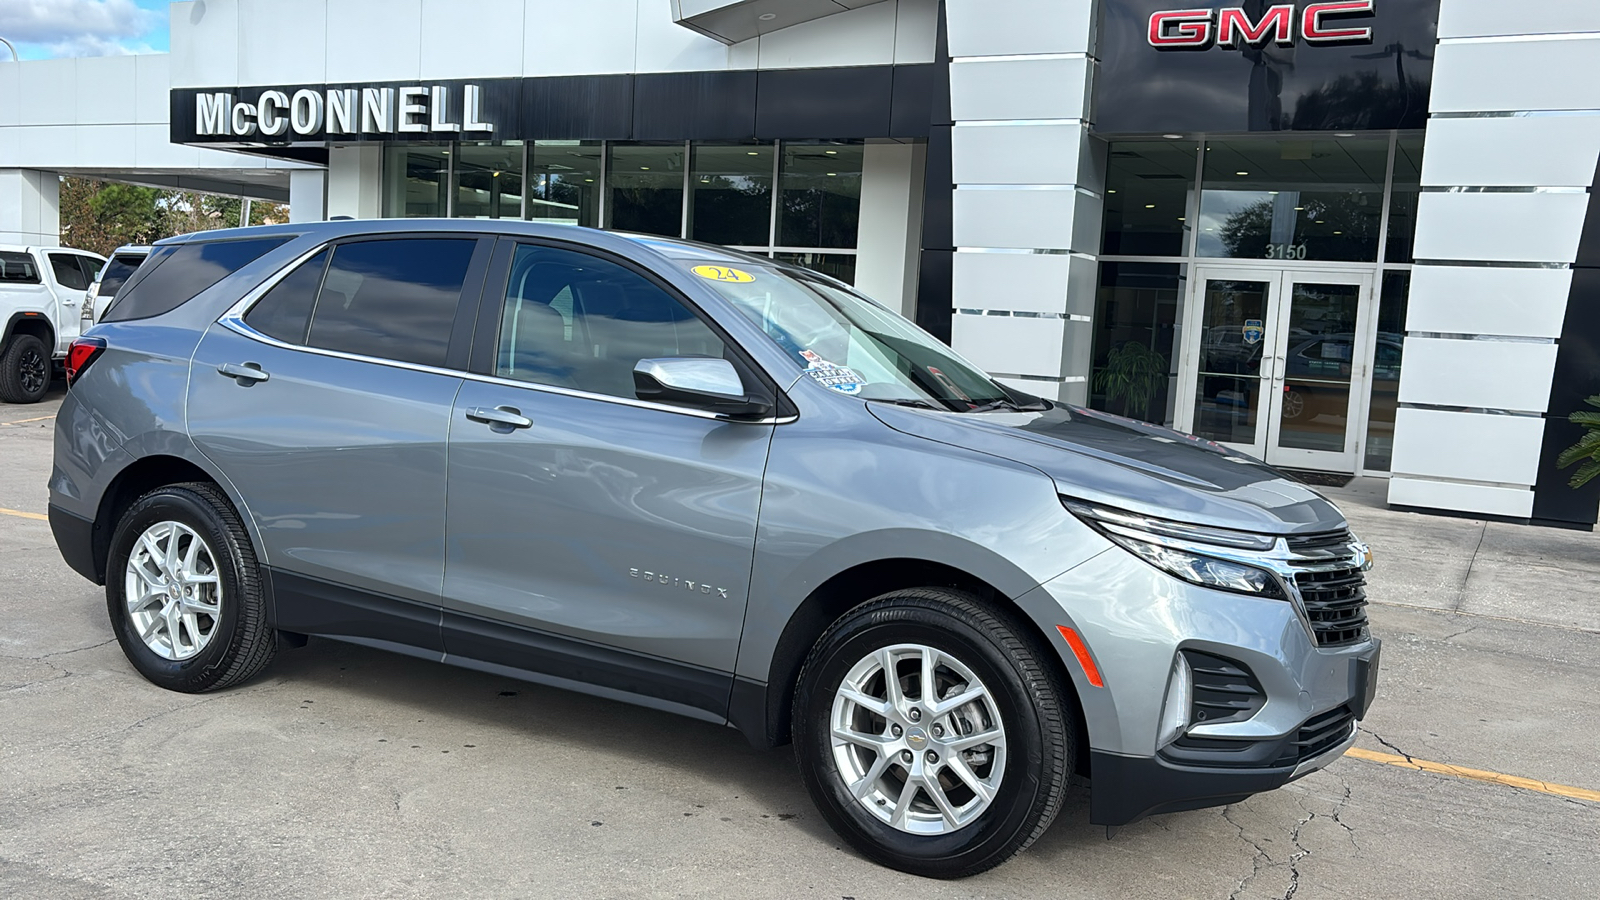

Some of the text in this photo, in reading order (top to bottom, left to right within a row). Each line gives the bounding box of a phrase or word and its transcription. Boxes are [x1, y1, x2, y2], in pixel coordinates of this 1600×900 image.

[1147, 0, 1375, 47] GMC
[195, 84, 494, 136] McCONNELL
[1264, 243, 1307, 260] 3150
[708, 267, 740, 281] 24
[629, 567, 728, 599] EQUINOX
